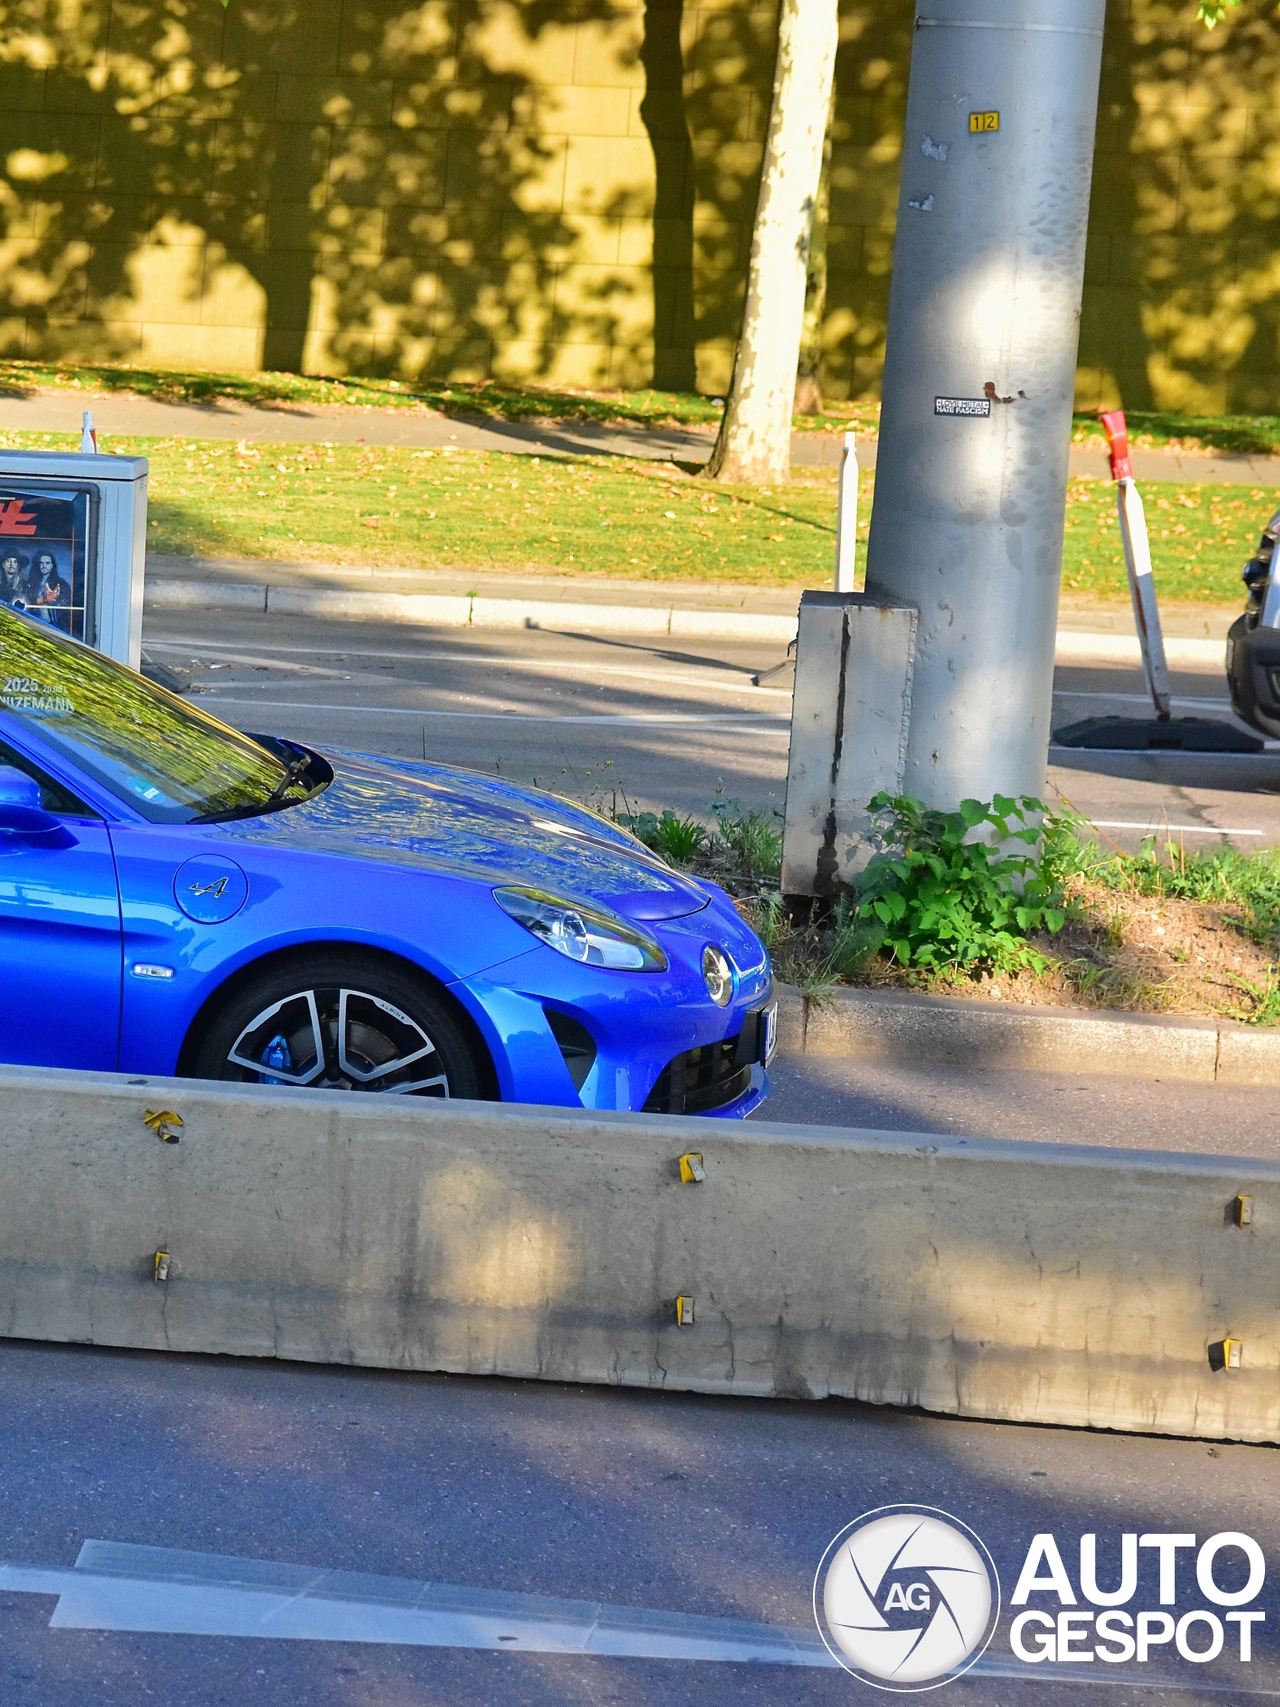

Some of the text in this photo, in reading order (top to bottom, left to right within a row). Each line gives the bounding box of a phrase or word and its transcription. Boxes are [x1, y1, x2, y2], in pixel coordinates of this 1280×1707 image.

[974, 115, 995, 130] 12
[956, 407, 988, 415] FASCISM
[4, 677, 39, 693] 2025
[380, 1003, 406, 1021] ALPINE
